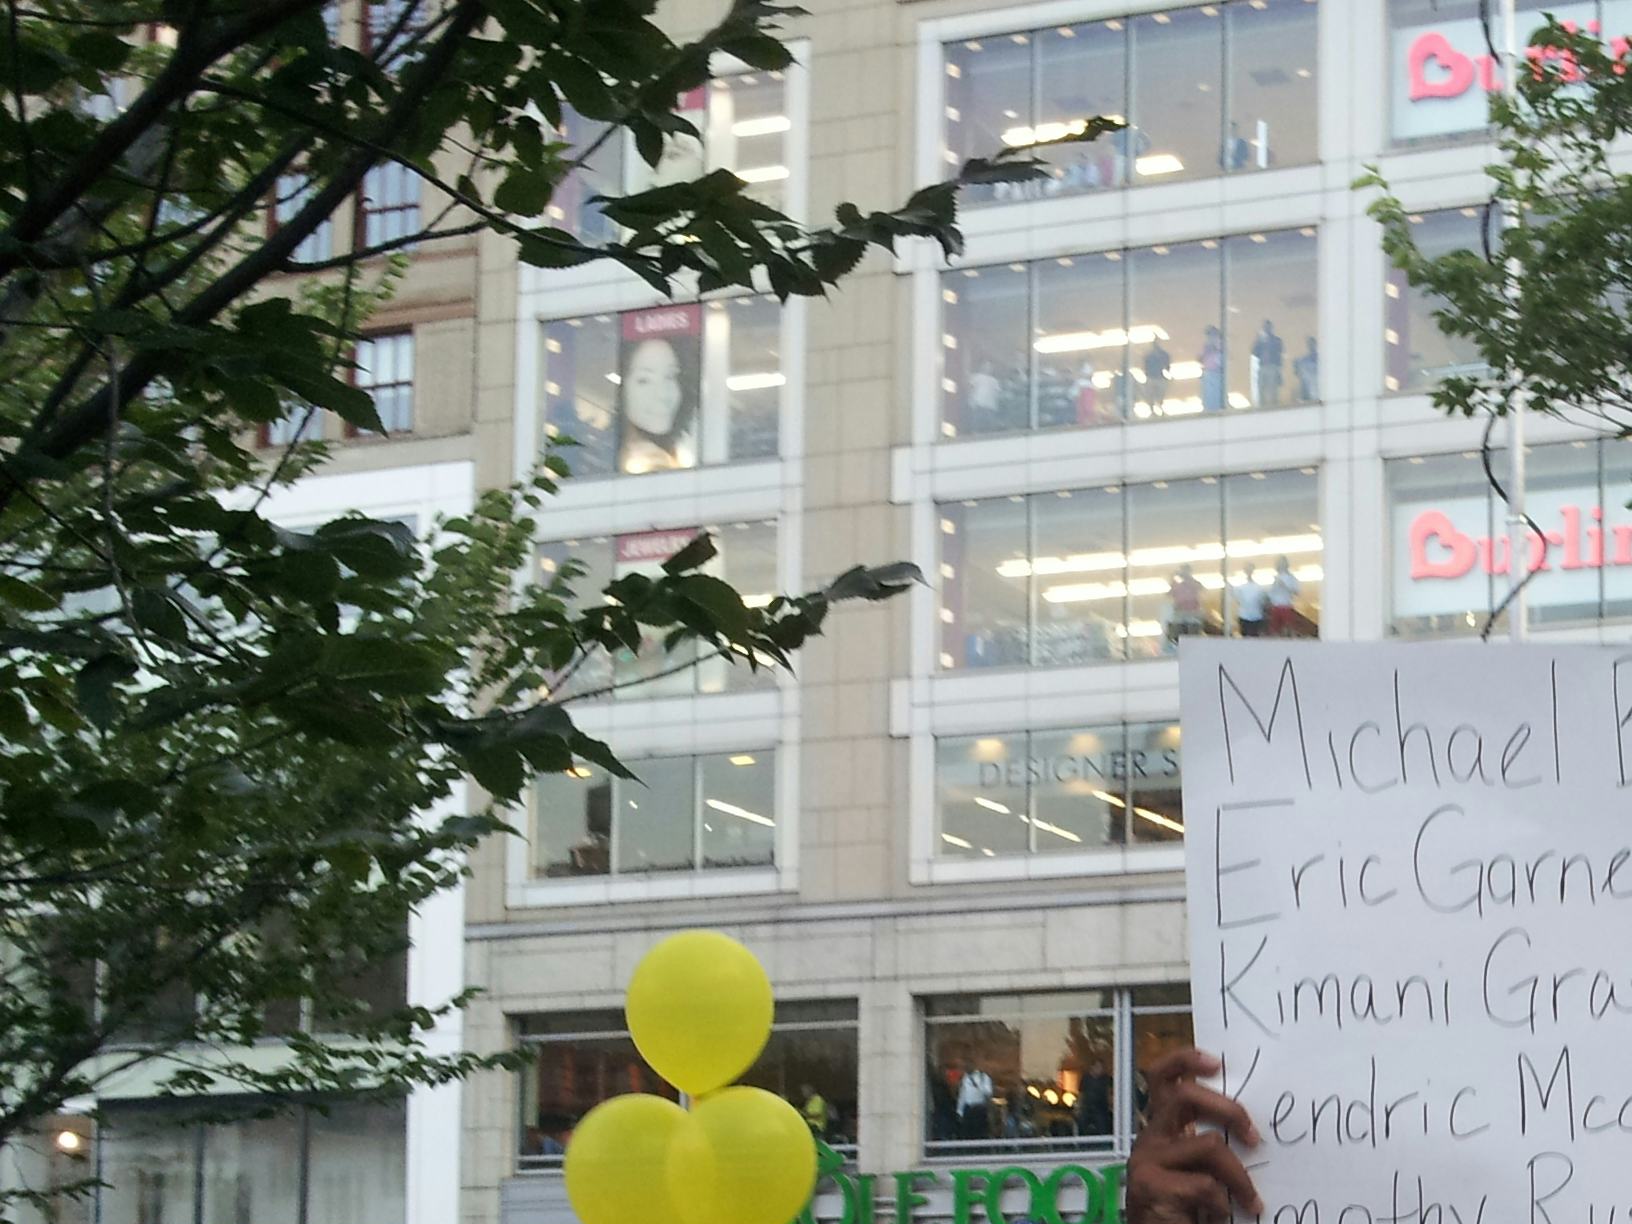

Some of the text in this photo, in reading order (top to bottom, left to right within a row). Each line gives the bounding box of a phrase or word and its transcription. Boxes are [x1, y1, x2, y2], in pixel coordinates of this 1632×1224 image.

[977, 750, 1148, 788] DESIGNER
[1217, 656, 1560, 795] Michael
[1216, 799, 1398, 929] Eric
[1220, 936, 1449, 1040] Kimani
